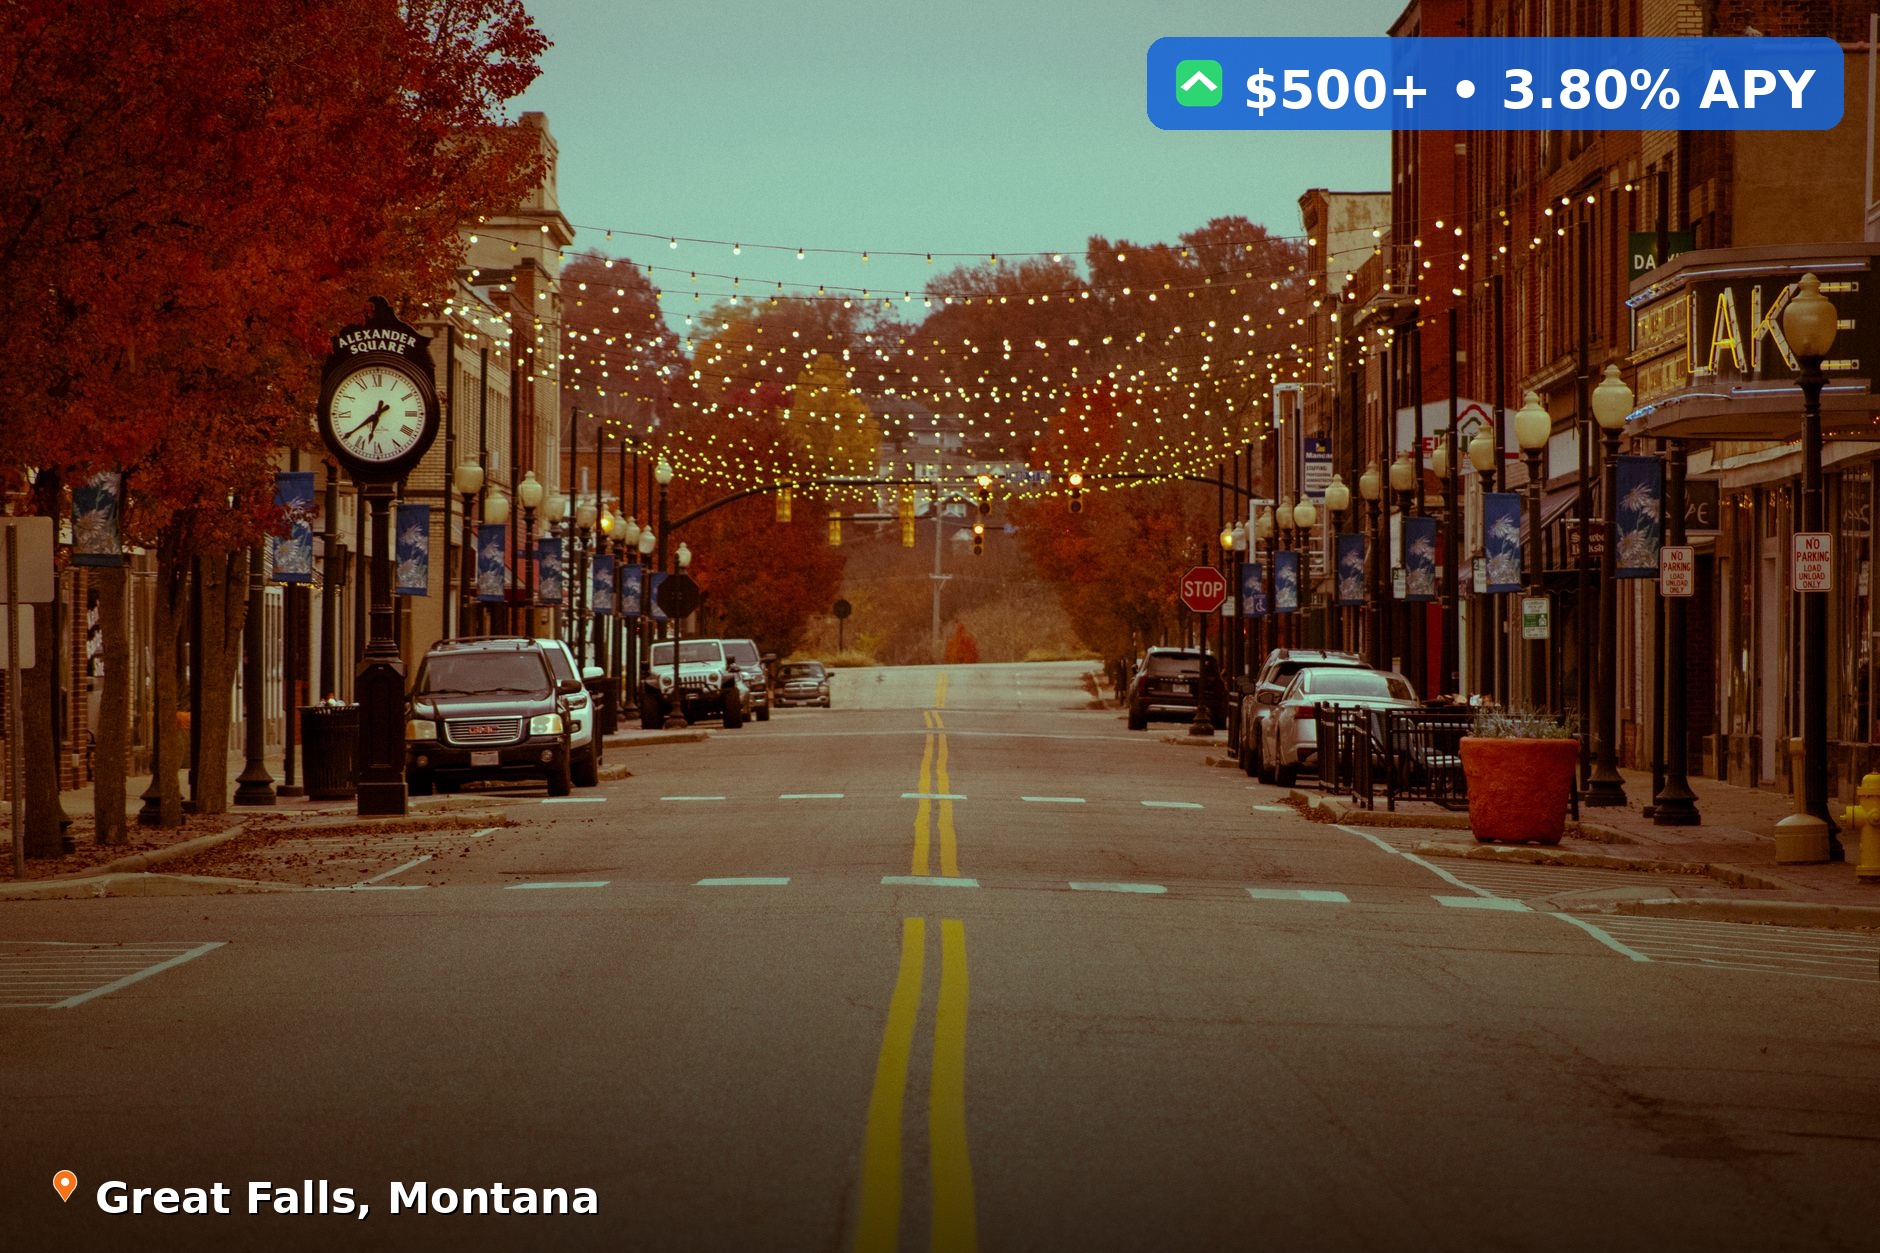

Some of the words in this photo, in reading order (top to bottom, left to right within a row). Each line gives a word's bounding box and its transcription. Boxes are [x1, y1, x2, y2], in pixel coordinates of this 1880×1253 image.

[339, 329, 416, 348] ALEXANDER
[350, 341, 406, 355] SQUARE
[1806, 538, 1820, 550] NO
[1671, 551, 1683, 561] NO
[1796, 551, 1830, 562] PARKING
[1663, 562, 1691, 572] PARKING
[1804, 564, 1822, 572] LOAD
[1184, 580, 1224, 598] STOP
[1803, 581, 1821, 589] ONLY
